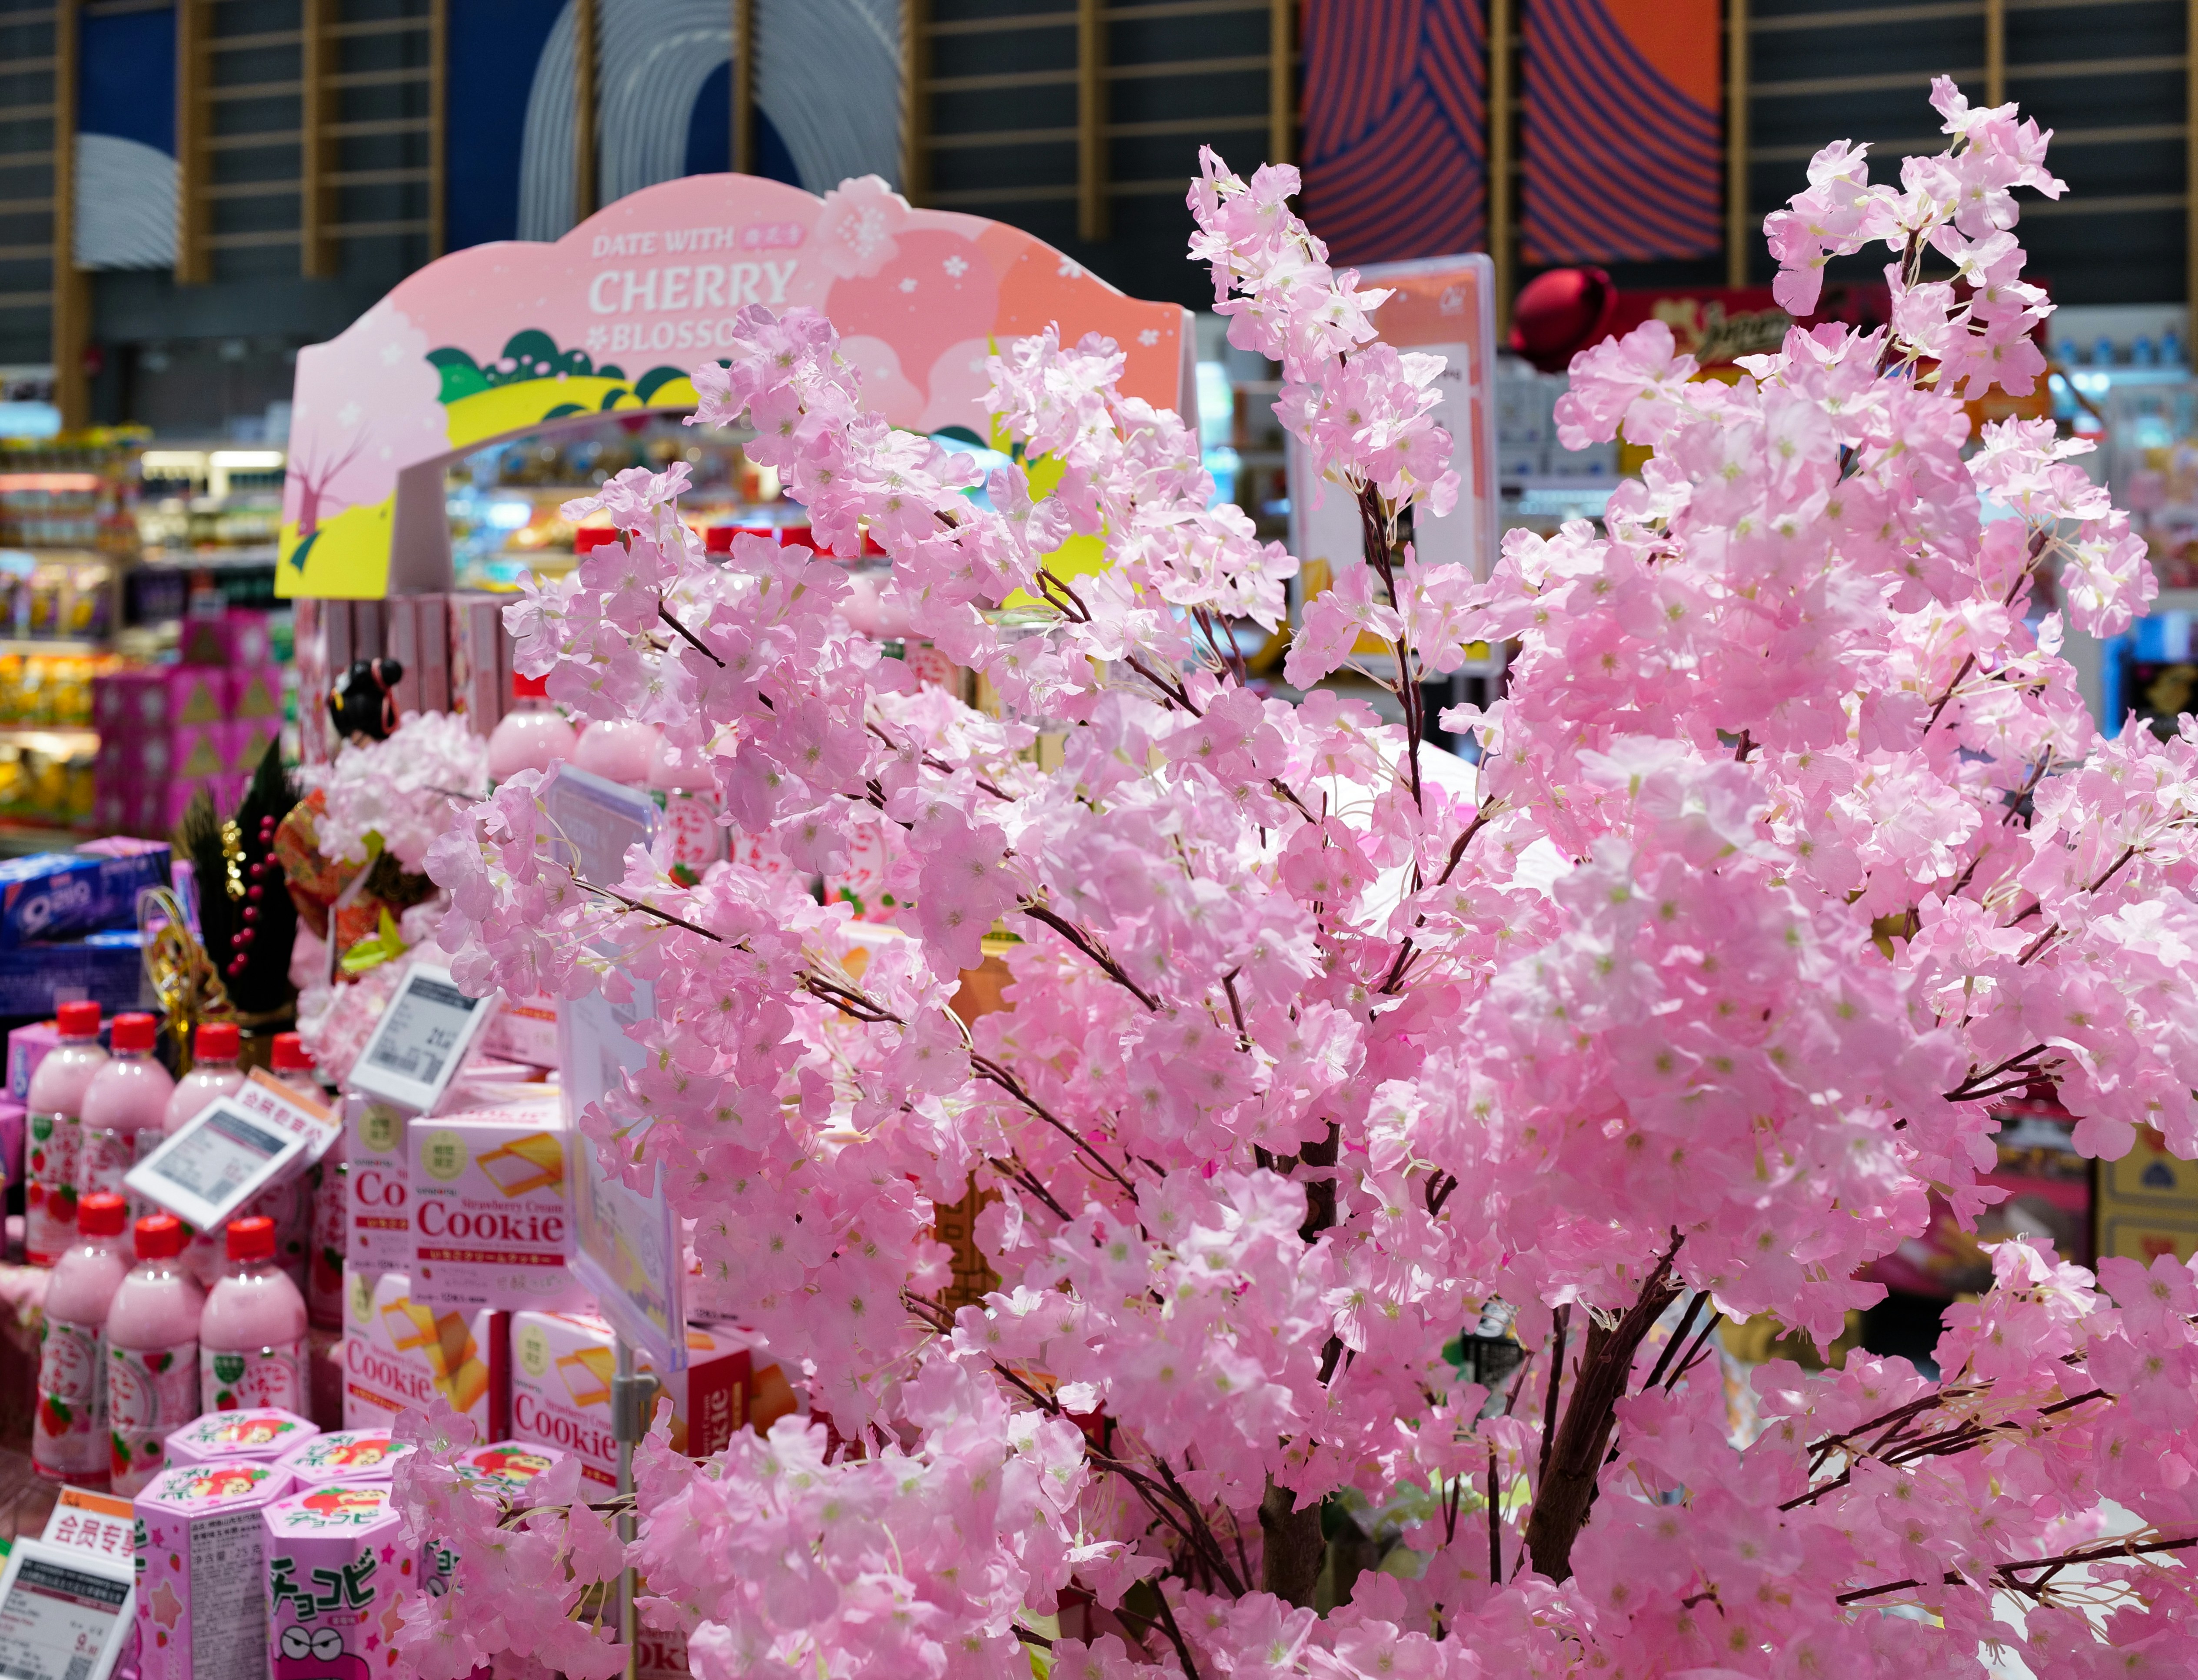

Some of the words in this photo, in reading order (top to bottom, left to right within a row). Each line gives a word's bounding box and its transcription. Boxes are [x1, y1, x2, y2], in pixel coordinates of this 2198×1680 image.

[592, 232, 657, 257] DATE
[664, 226, 734, 252] WITH
[589, 260, 798, 314] CHERRY
[610, 319, 735, 352] BLOSSO
[416, 1199, 564, 1242] Cookie
[461, 1198, 522, 1214] Strawberry
[525, 1201, 563, 1212] Cream
[347, 1338, 431, 1403] Cookie
[515, 1394, 617, 1463] Cookie
[270, 1547, 377, 1621] チョコビ
